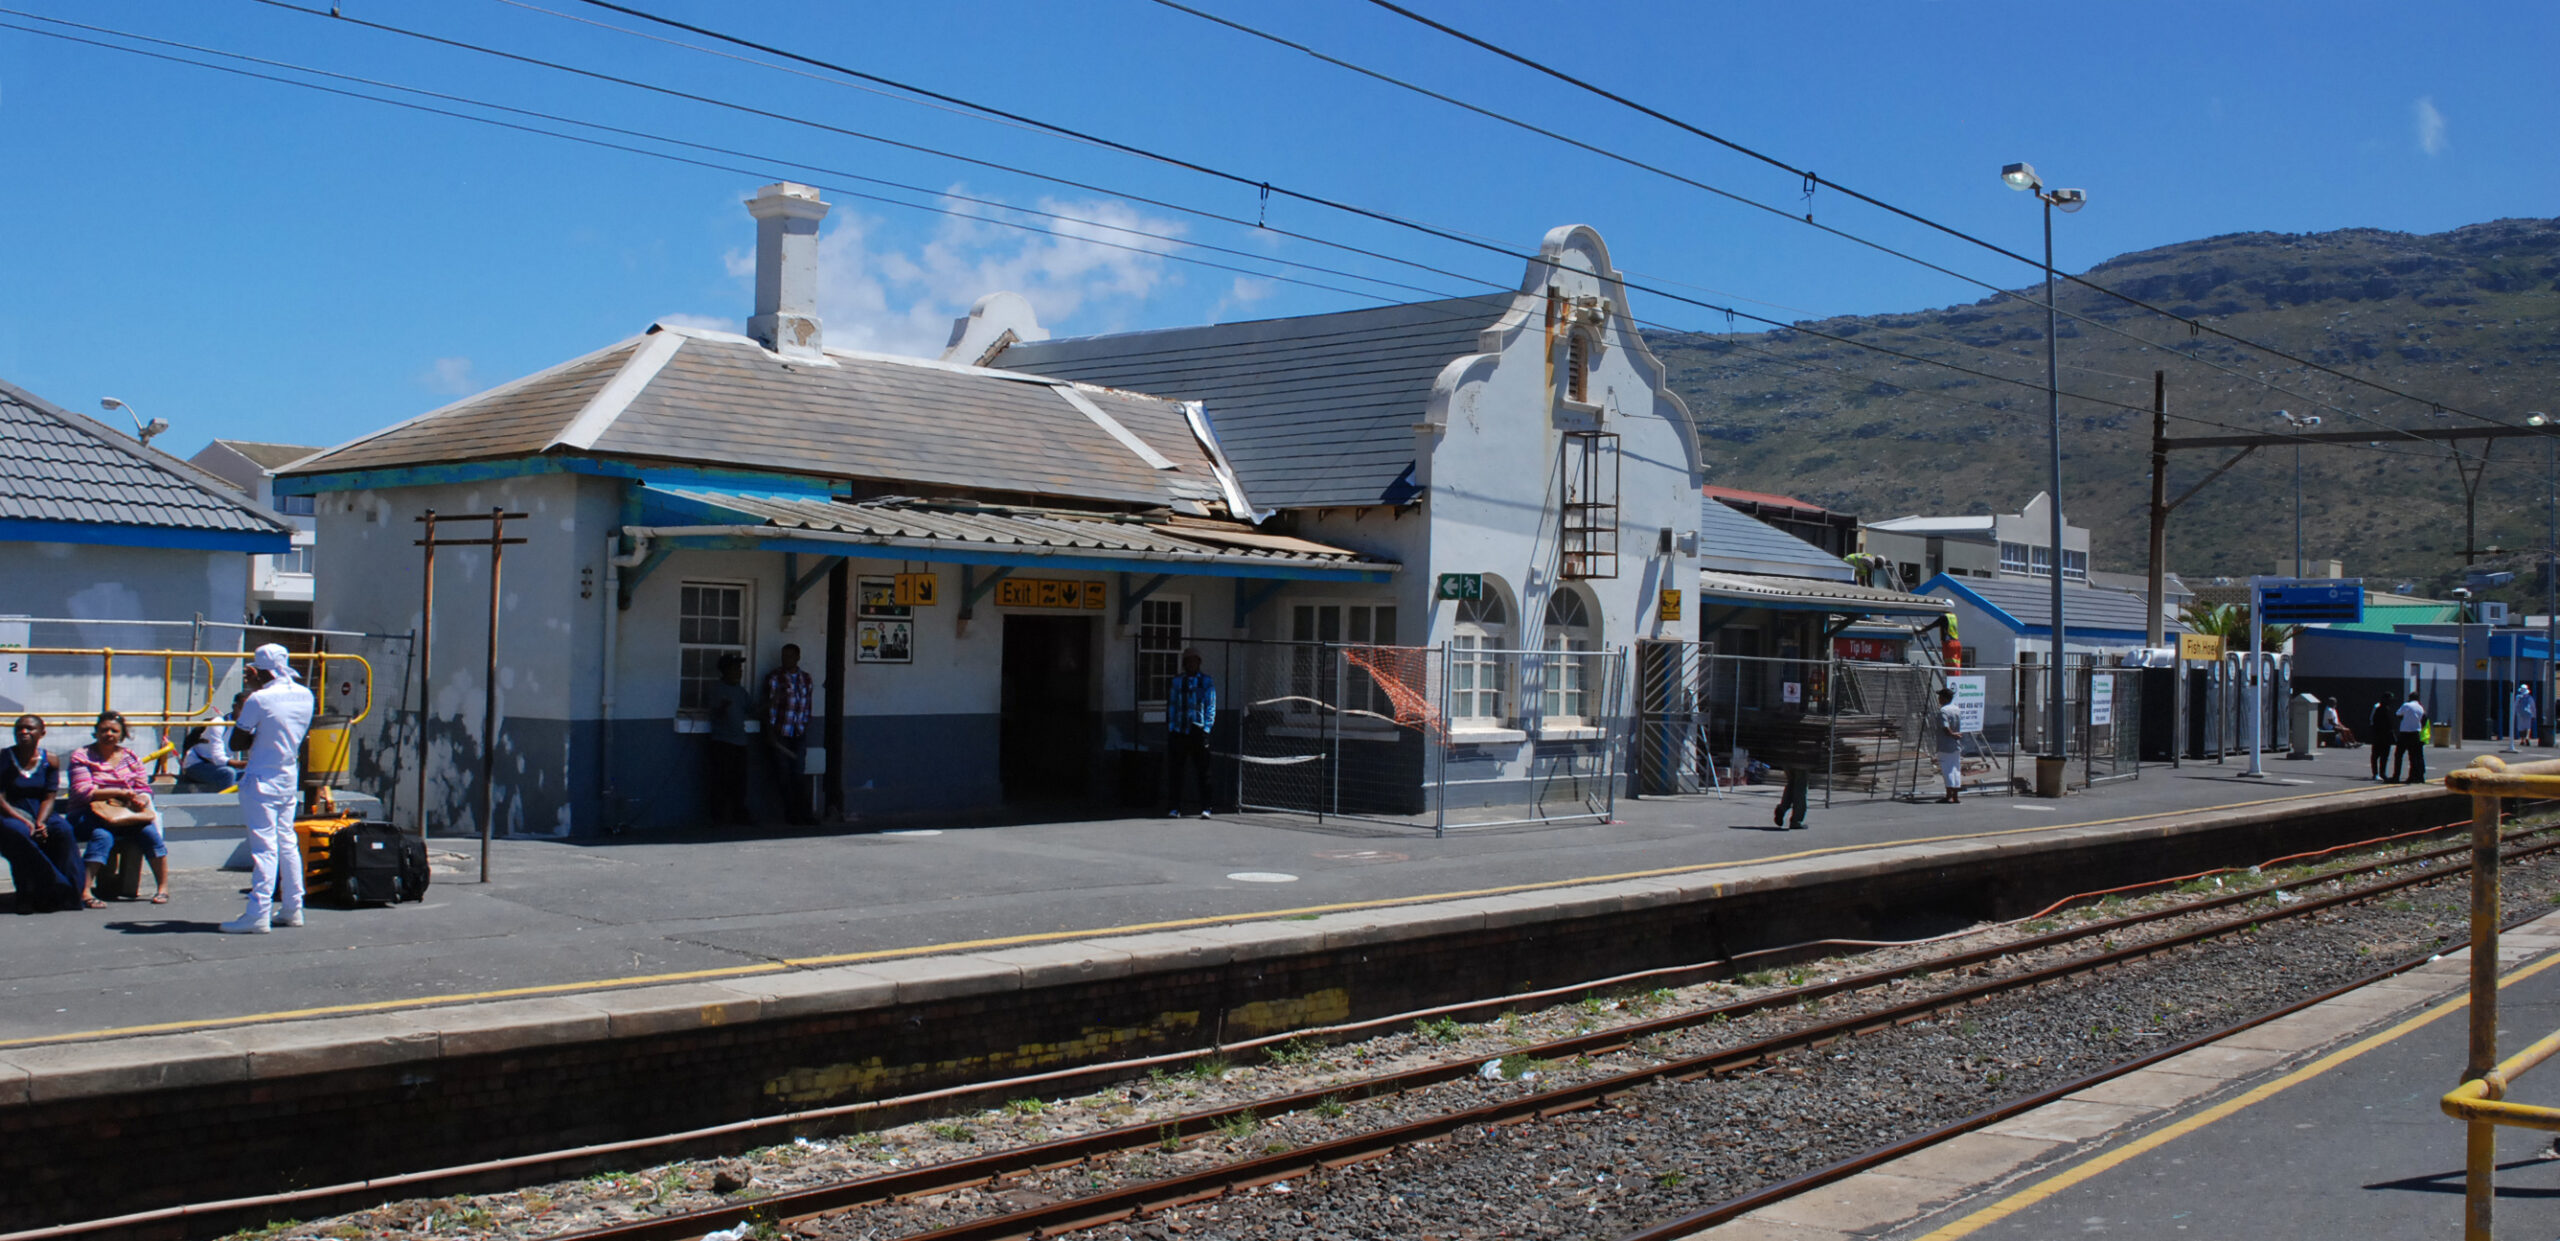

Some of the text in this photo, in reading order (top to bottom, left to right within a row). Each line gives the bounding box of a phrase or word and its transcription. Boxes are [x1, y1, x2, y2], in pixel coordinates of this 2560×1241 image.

[901, 578, 908, 601] 1
[1003, 581, 1032, 604] Exit
[1850, 640, 1860, 656] Tip
[2187, 639, 2201, 655] Fish
[9, 662, 18, 672] 2
